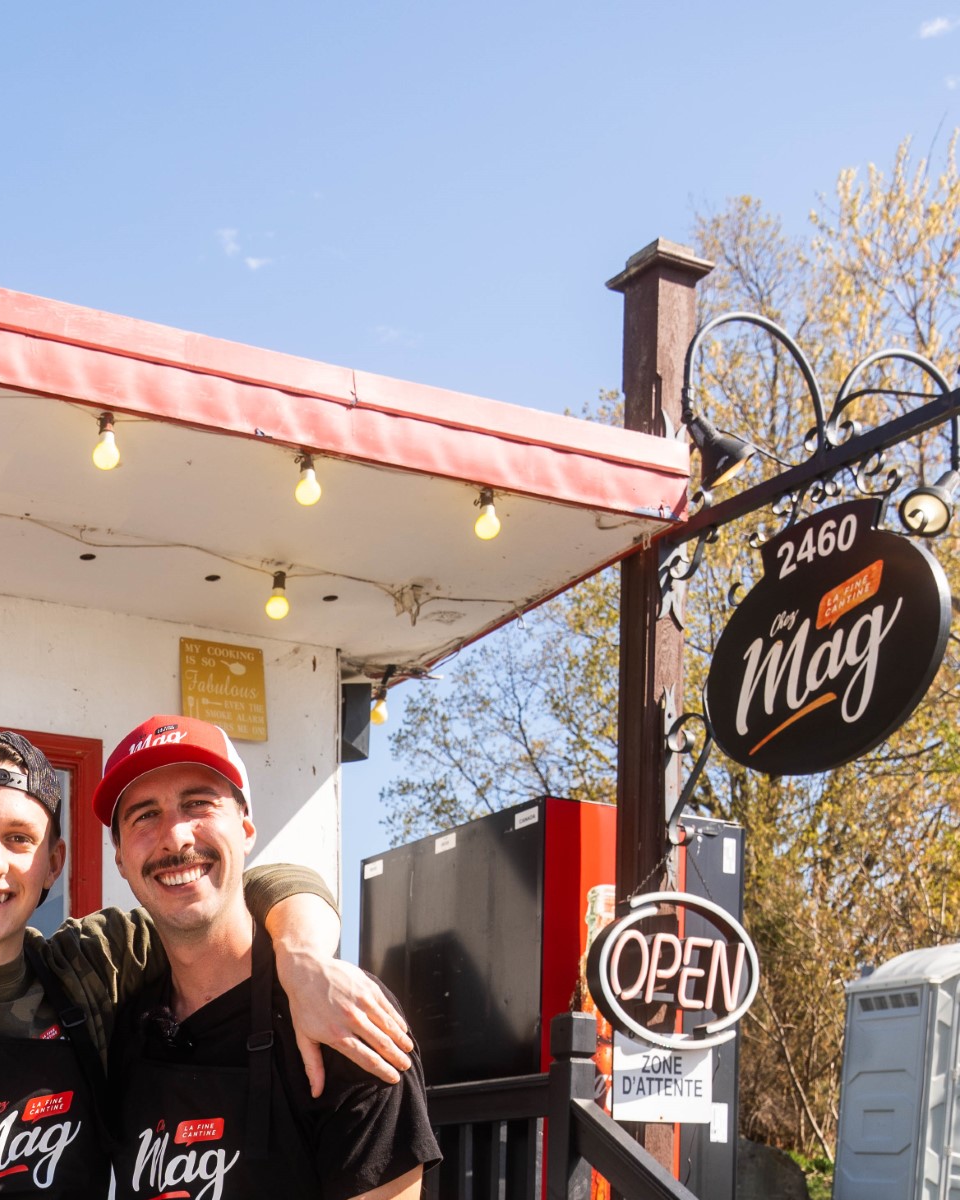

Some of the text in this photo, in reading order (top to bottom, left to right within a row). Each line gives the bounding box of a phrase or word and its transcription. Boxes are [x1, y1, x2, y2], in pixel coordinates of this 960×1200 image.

[777, 514, 858, 580] 2460
[824, 584, 872, 617] CANTINE
[826, 575, 869, 606] LA FINE
[770, 608, 800, 638] Chez
[185, 643, 255, 661] MY COOKING
[186, 655, 216, 667] IS SO
[736, 597, 902, 736] Mag
[185, 669, 257, 699] Fabulous
[519, 814, 536, 824] CANADA
[611, 929, 746, 1012] OPEN
[642, 1055, 682, 1075] ZONE
[622, 1076, 703, 1098] D'ATTENTE
[29, 1103, 64, 1115] CANTINE
[45, 1097, 63, 1106] FINE
[182, 1129, 216, 1138] CANTINE
[197, 1122, 215, 1130] FINE
